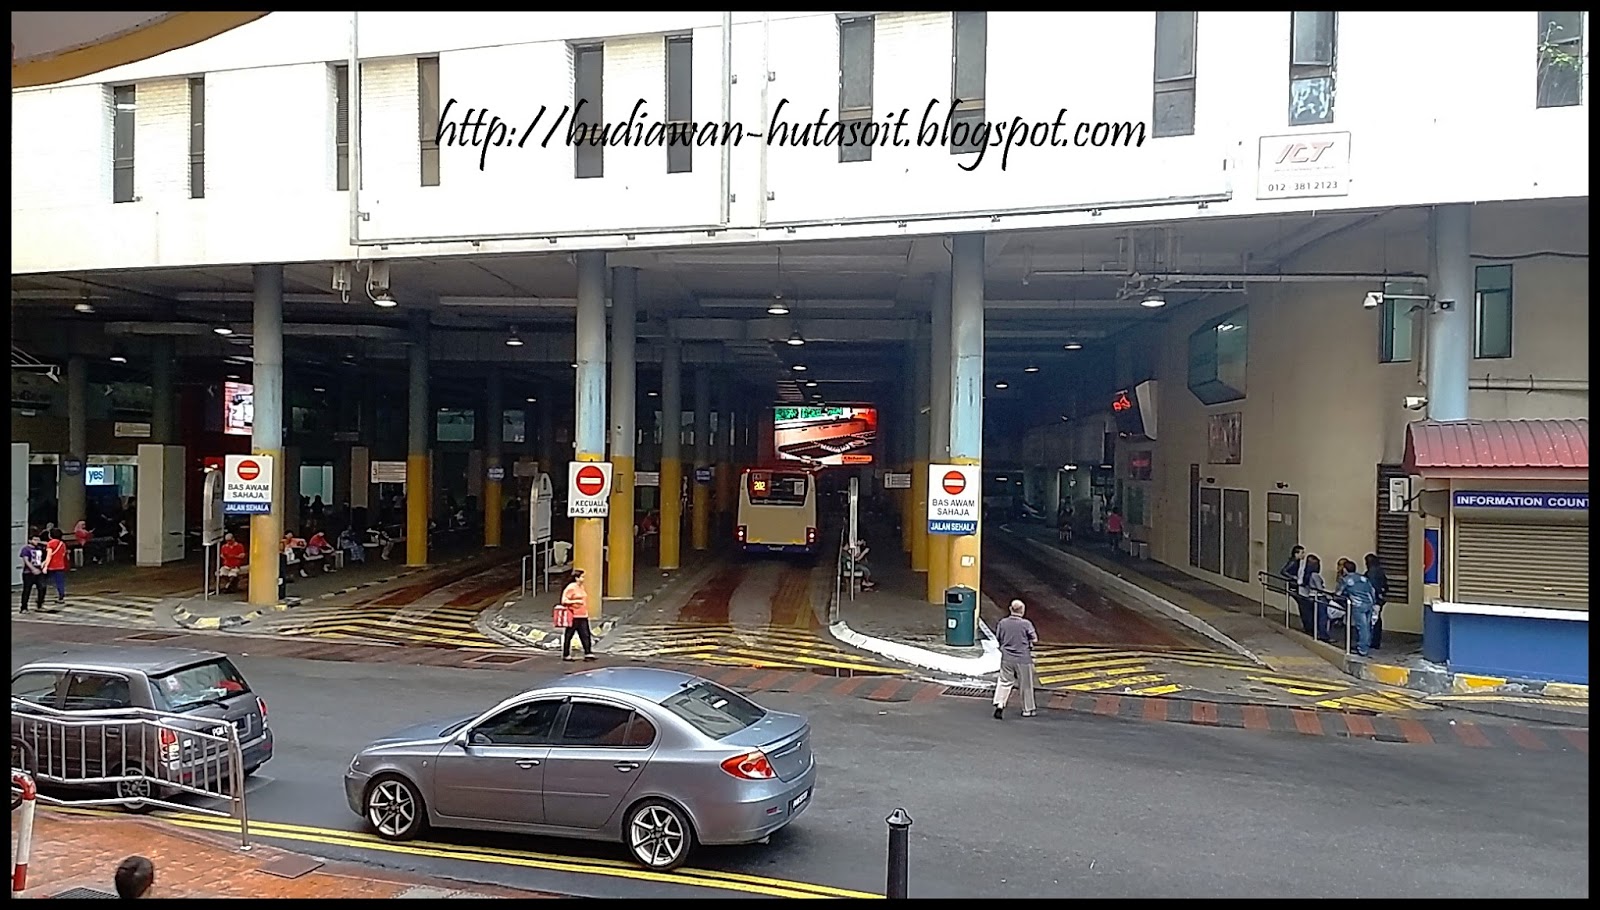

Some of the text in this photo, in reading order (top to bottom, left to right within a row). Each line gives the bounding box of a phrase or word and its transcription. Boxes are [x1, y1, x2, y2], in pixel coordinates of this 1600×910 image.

[1275, 141, 1334, 164] ICT
[1314, 181, 1338, 189] 2123
[88, 470, 103, 483] yes
[754, 481, 765, 490] 202
[950, 499, 974, 507] AWAM
[1457, 496, 1542, 506] INFORMATION
[937, 508, 969, 516] SAHAJA
[931, 522, 974, 531] JALAN SEHALA
